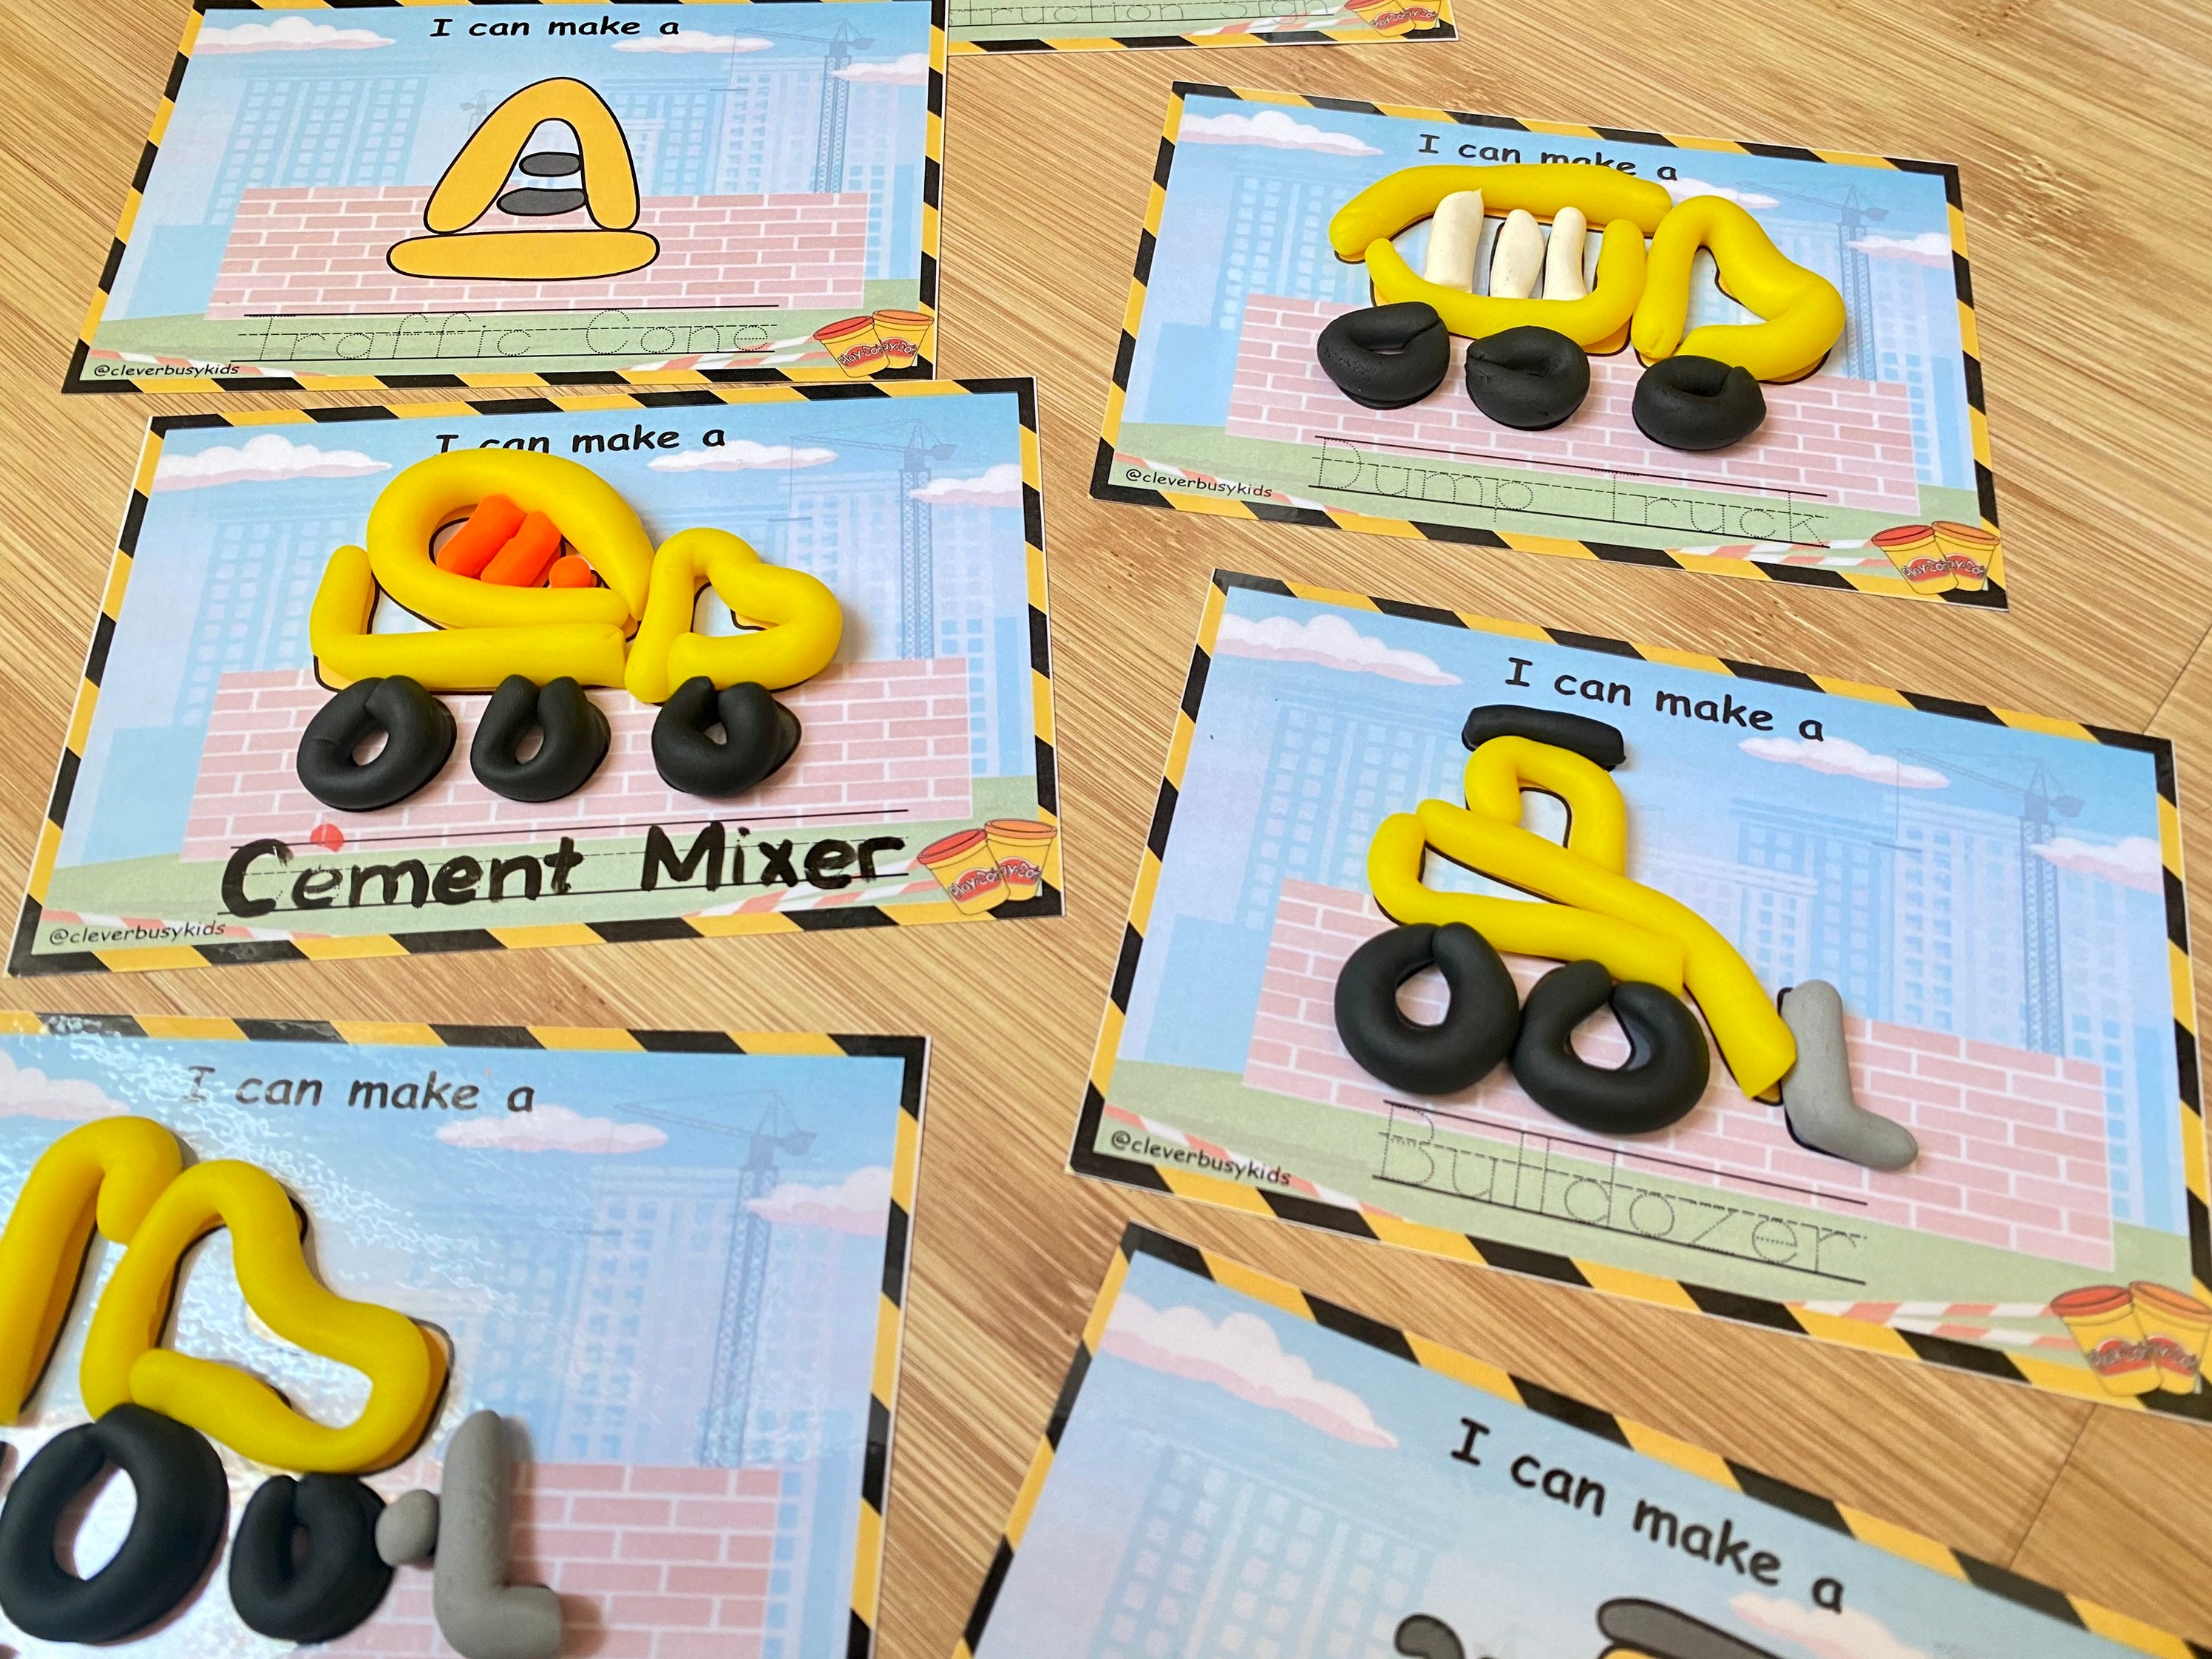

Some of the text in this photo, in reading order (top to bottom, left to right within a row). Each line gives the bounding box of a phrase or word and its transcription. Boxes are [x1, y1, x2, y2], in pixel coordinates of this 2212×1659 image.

[430, 16, 679, 37] I can make a
[1418, 134, 1440, 154] I
[1458, 143, 1521, 164] can
[1657, 166, 1678, 181] a
[249, 309, 768, 360] Traffic Cone
[94, 364, 240, 378] @cleverbusykids
[434, 435, 459, 455] I
[572, 424, 679, 453] make
[702, 429, 725, 447] a
[1126, 469, 1272, 498] @cleverbusykids
[1319, 438, 1533, 522] Dump
[1504, 657, 1824, 742] I can make a
[221, 821, 906, 918] Cement Mixer
[50, 920, 225, 945] @cleverbusykids
[183, 1065, 535, 1113] I can make a
[1111, 1130, 1292, 1185] @cleverbusykids
[1381, 1104, 1857, 1273] Bulldozer
[1451, 1417, 1844, 1615] I can make a
